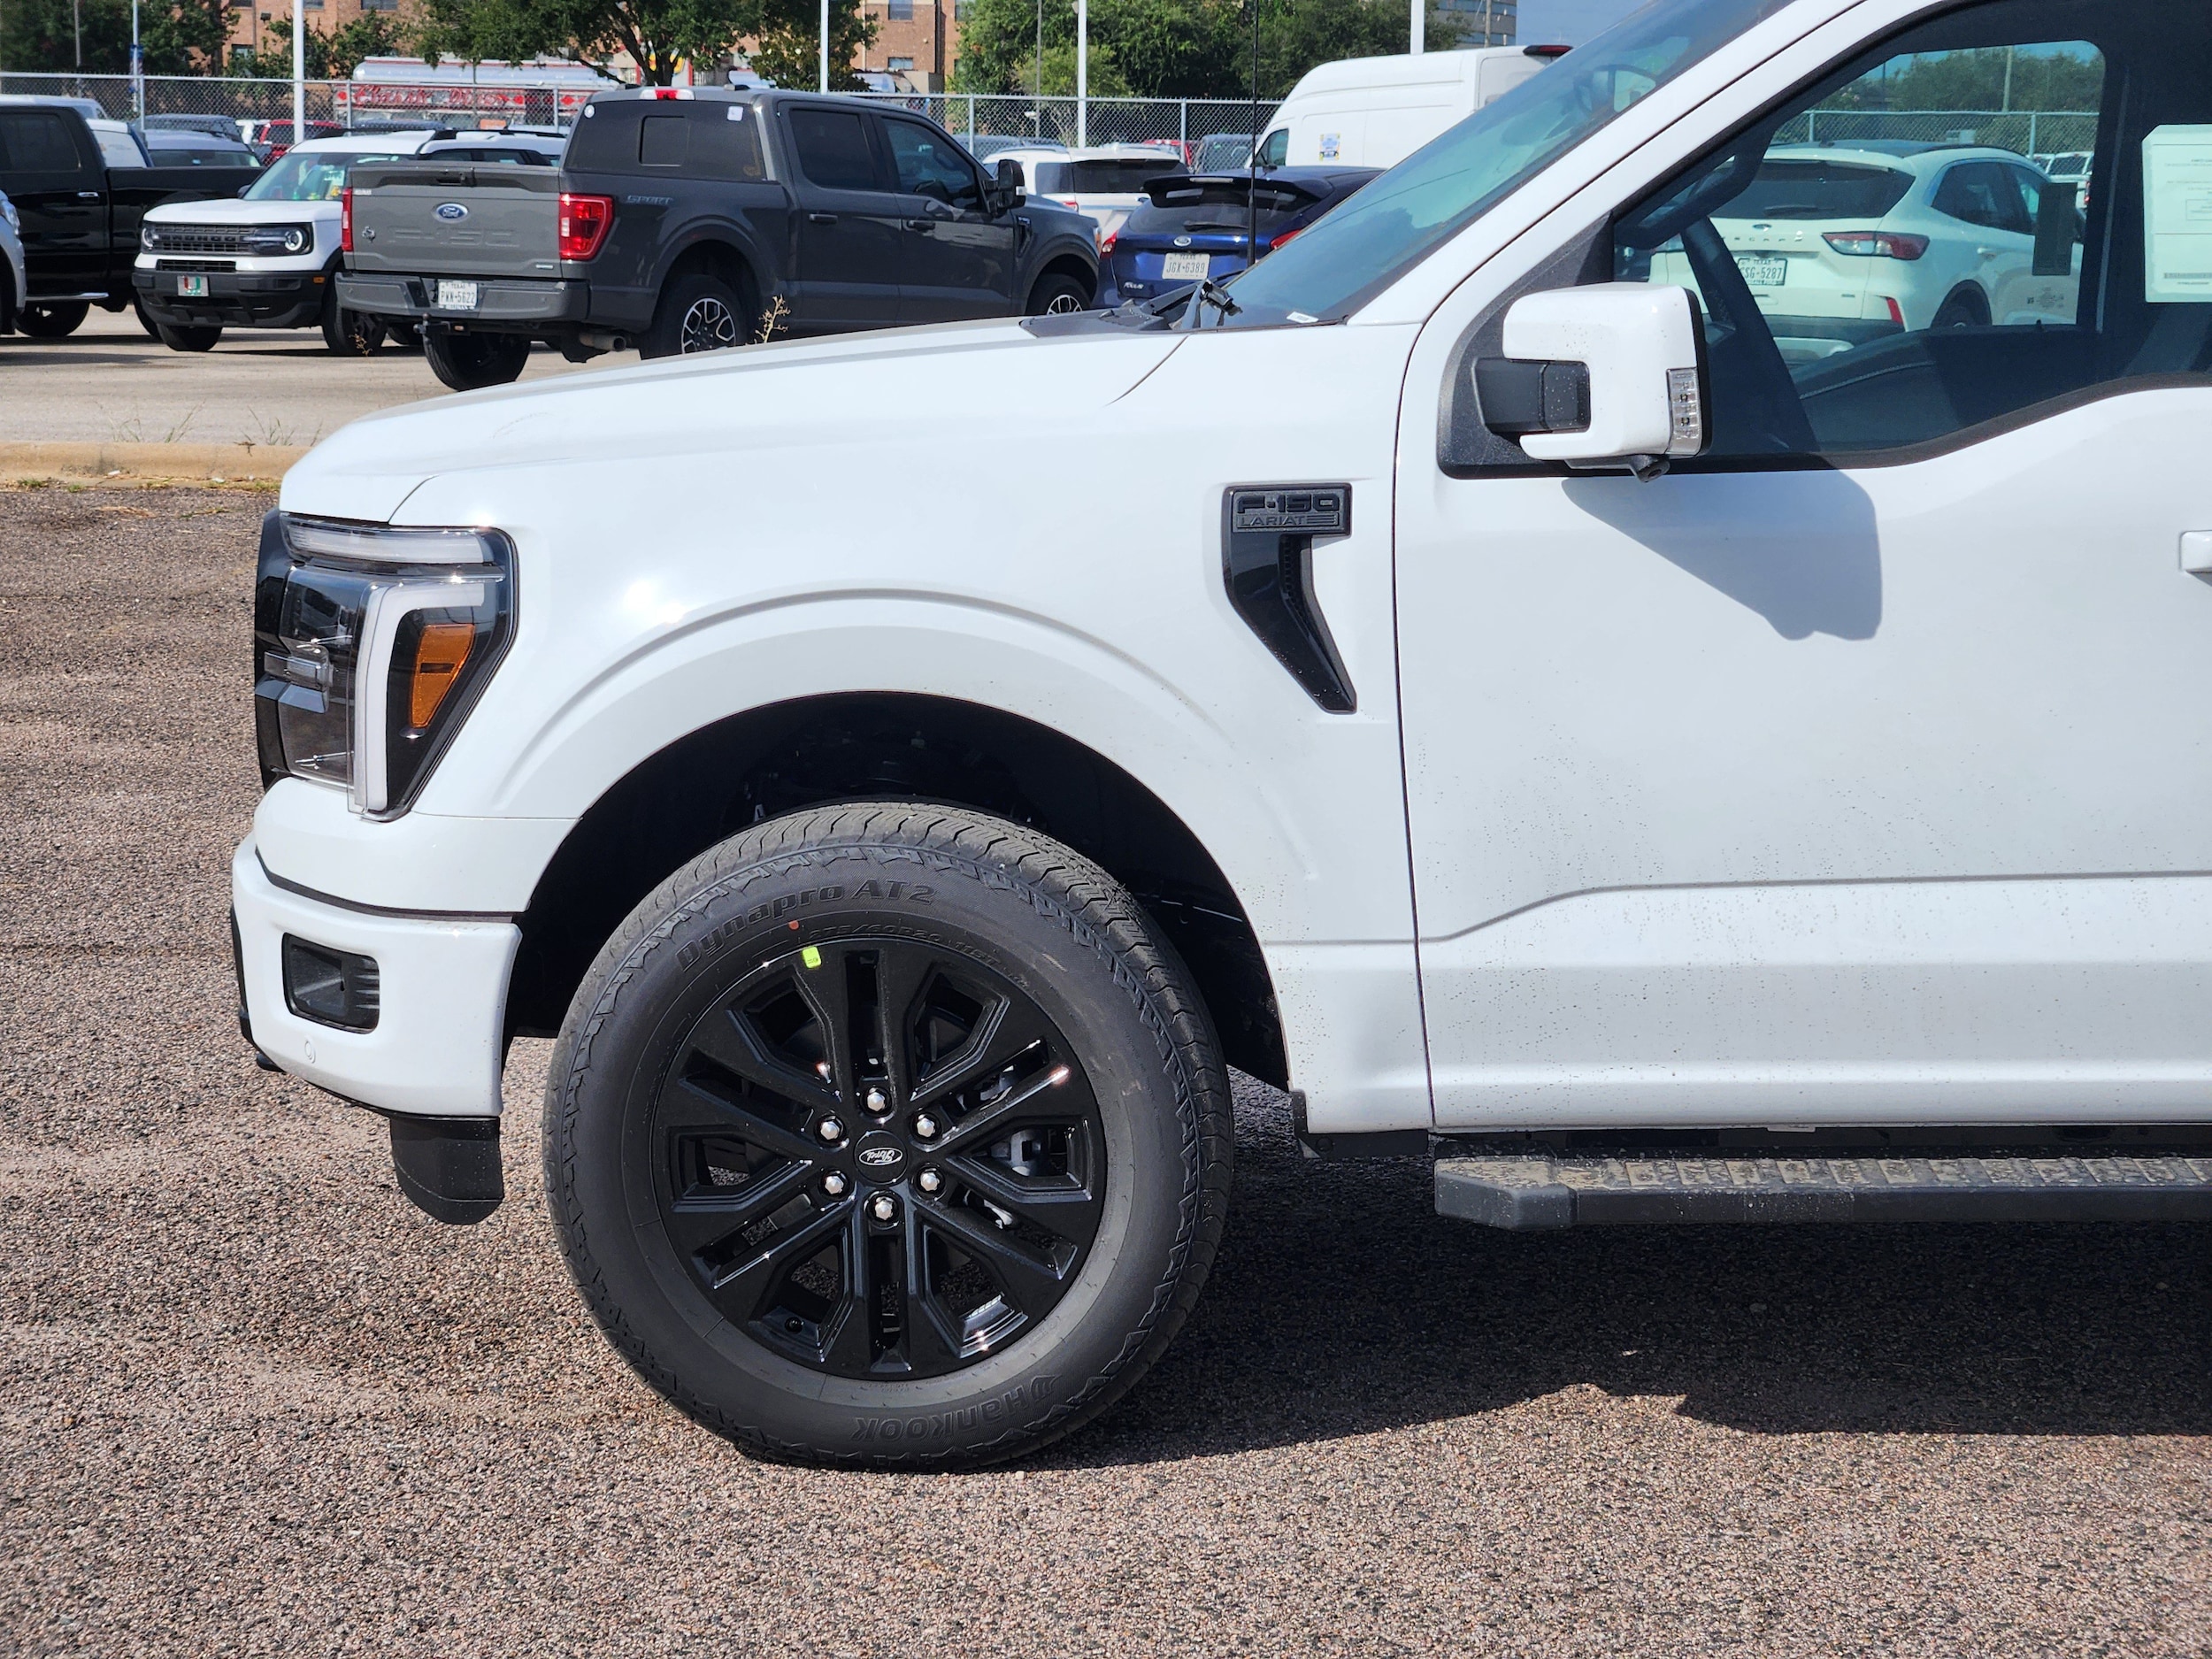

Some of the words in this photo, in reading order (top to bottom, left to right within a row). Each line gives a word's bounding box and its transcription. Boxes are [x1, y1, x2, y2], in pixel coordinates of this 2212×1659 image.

[626, 195, 673, 204] SPORT
[1237, 493, 1340, 513] F-150
[1240, 515, 1307, 526] LARIAT
[674, 883, 845, 972] Dynapro
[851, 879, 936, 906] AT2
